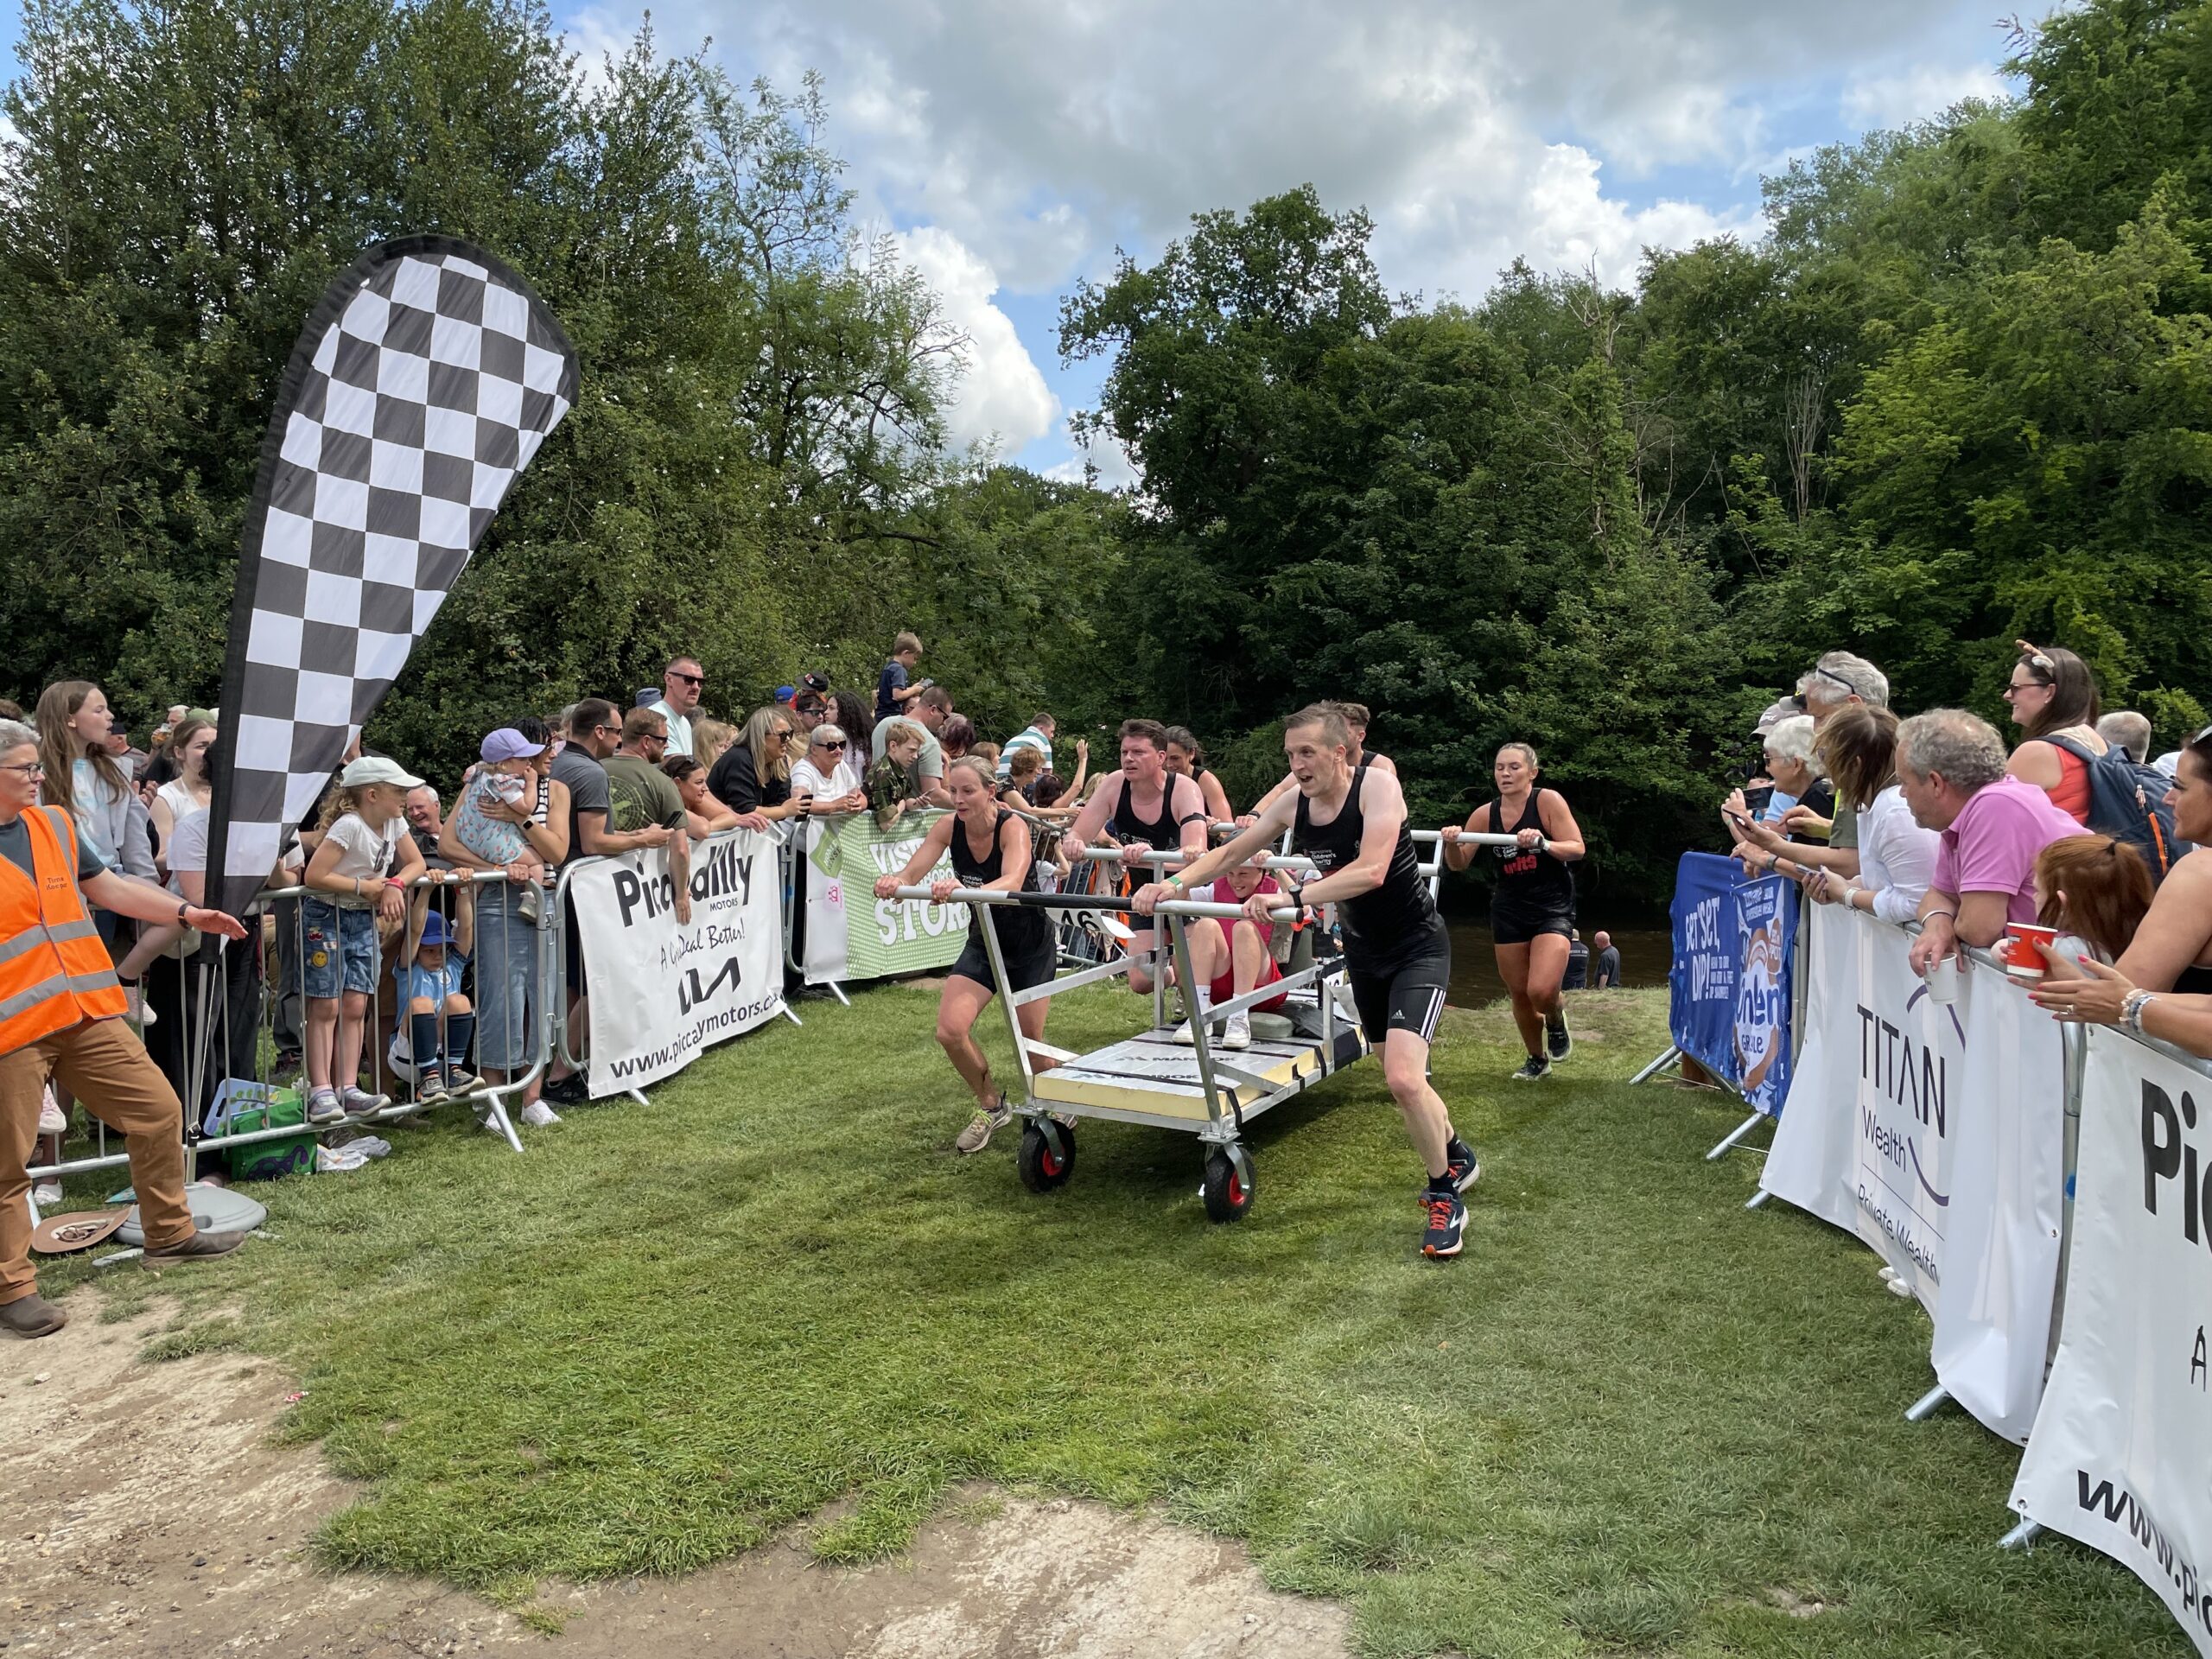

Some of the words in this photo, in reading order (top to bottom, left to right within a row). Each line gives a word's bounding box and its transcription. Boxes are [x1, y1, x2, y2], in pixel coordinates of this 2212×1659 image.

[869, 837, 926, 874] VIS
[706, 917, 746, 950] Better!
[709, 897, 739, 912] MOTORS
[1857, 1003, 1945, 1140] TITAN
[1862, 1104, 1906, 1173] Wealth
[1858, 1183, 1895, 1241] Private
[1896, 1219, 1941, 1287] Wealth
[2190, 1325, 2207, 1393] A
